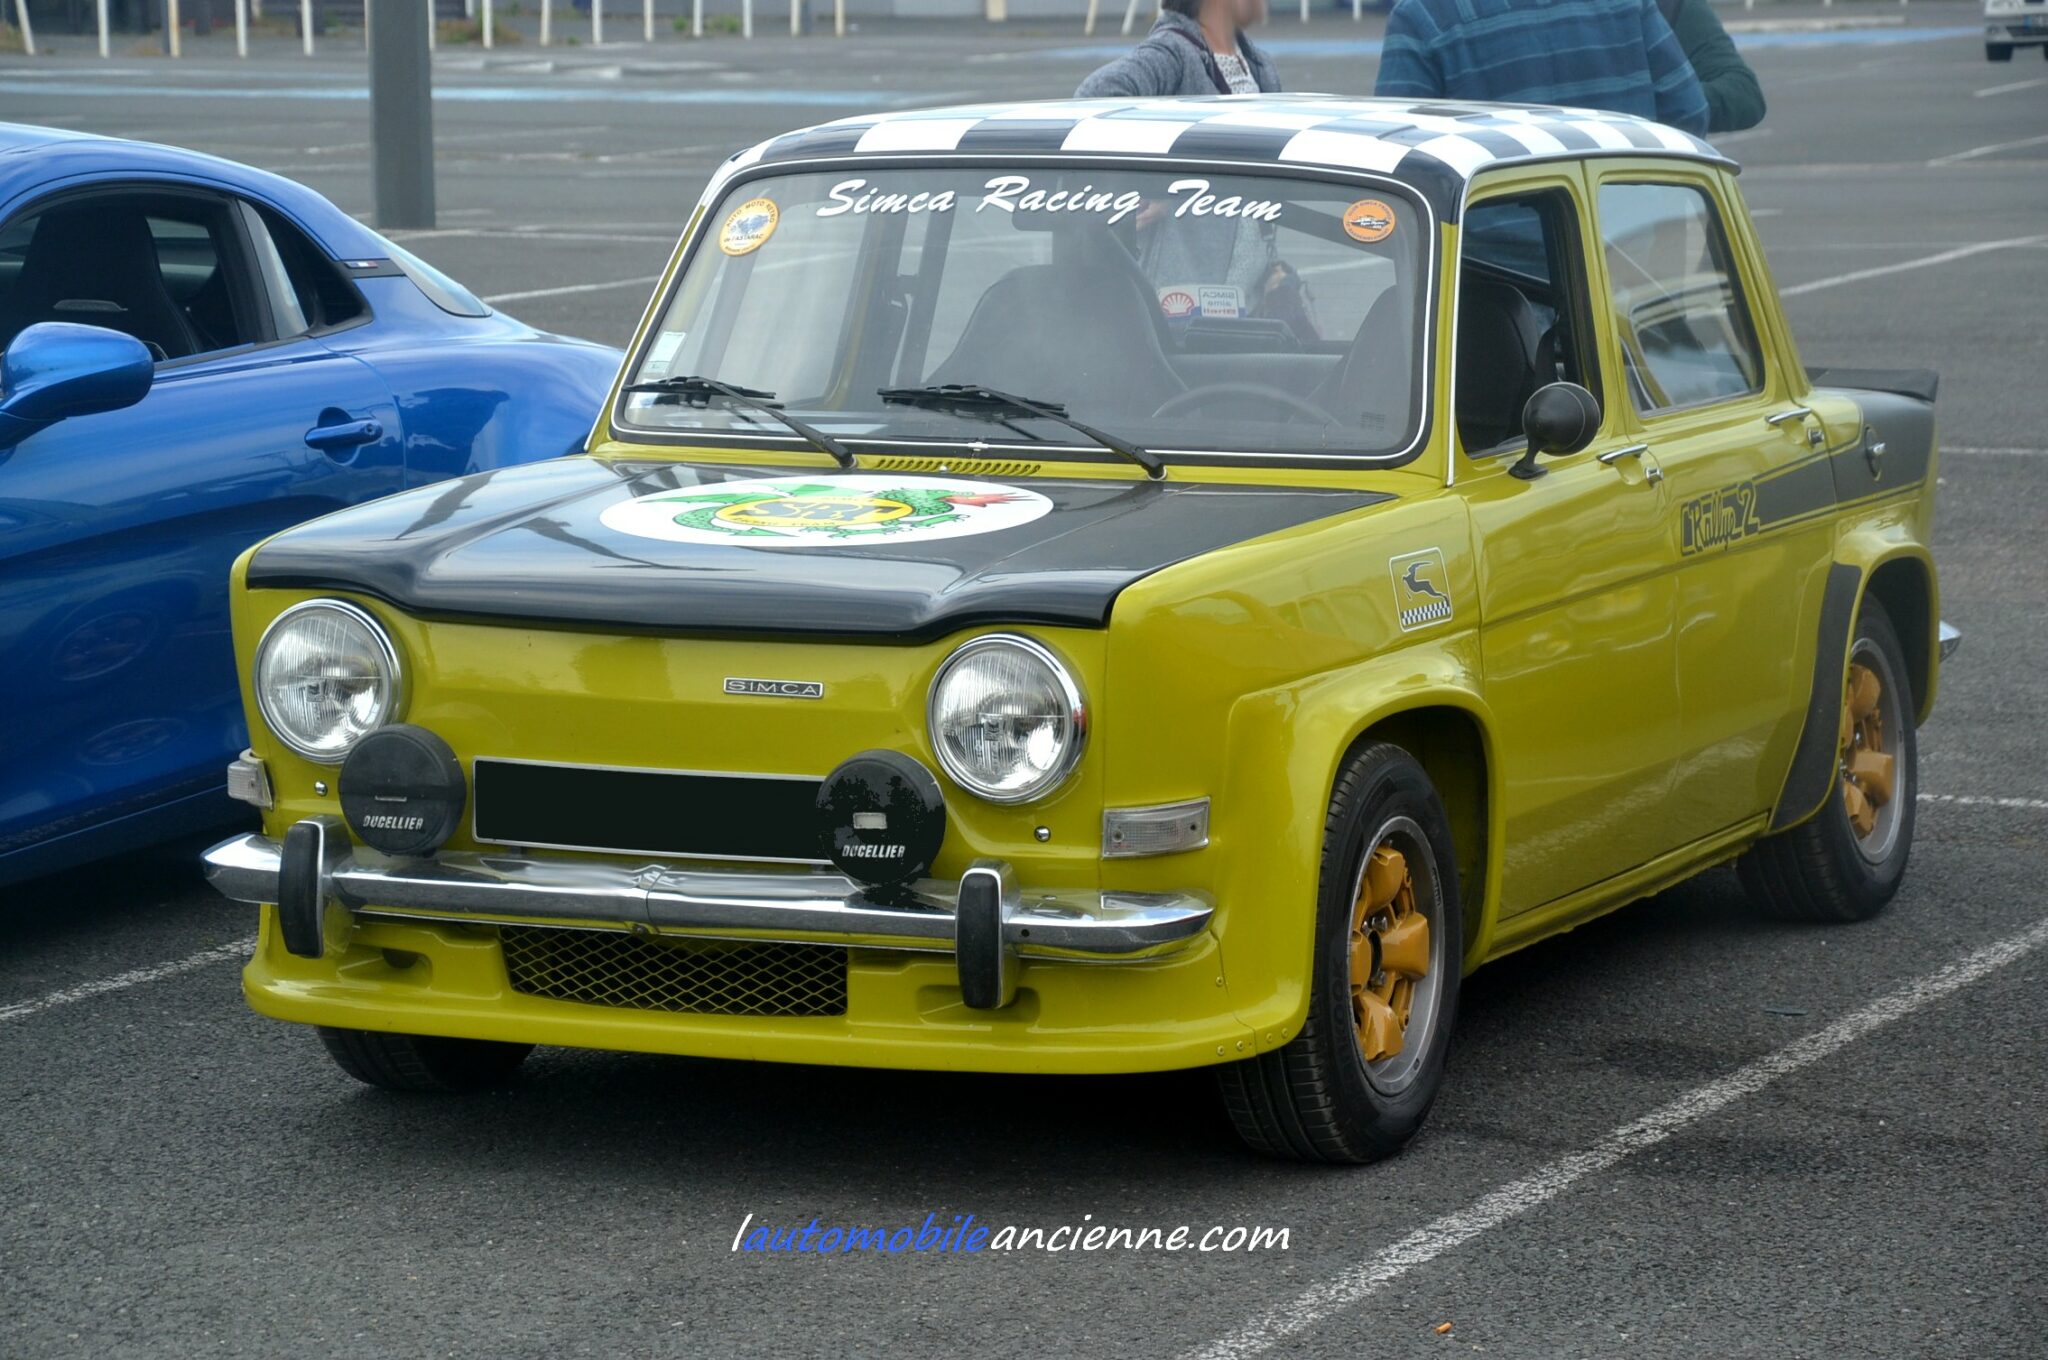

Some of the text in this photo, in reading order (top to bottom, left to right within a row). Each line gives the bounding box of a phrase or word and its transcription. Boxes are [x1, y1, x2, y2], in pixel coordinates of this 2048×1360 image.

[816, 175, 1283, 225] Simca Racing Team
[726, 209, 742, 227] AUTO
[745, 200, 766, 210] MOTO
[1737, 480, 1760, 537] 2
[728, 680, 818, 696] SIMCA
[362, 815, 424, 830] DUCELLIER
[841, 844, 906, 859] DUCELLIER
